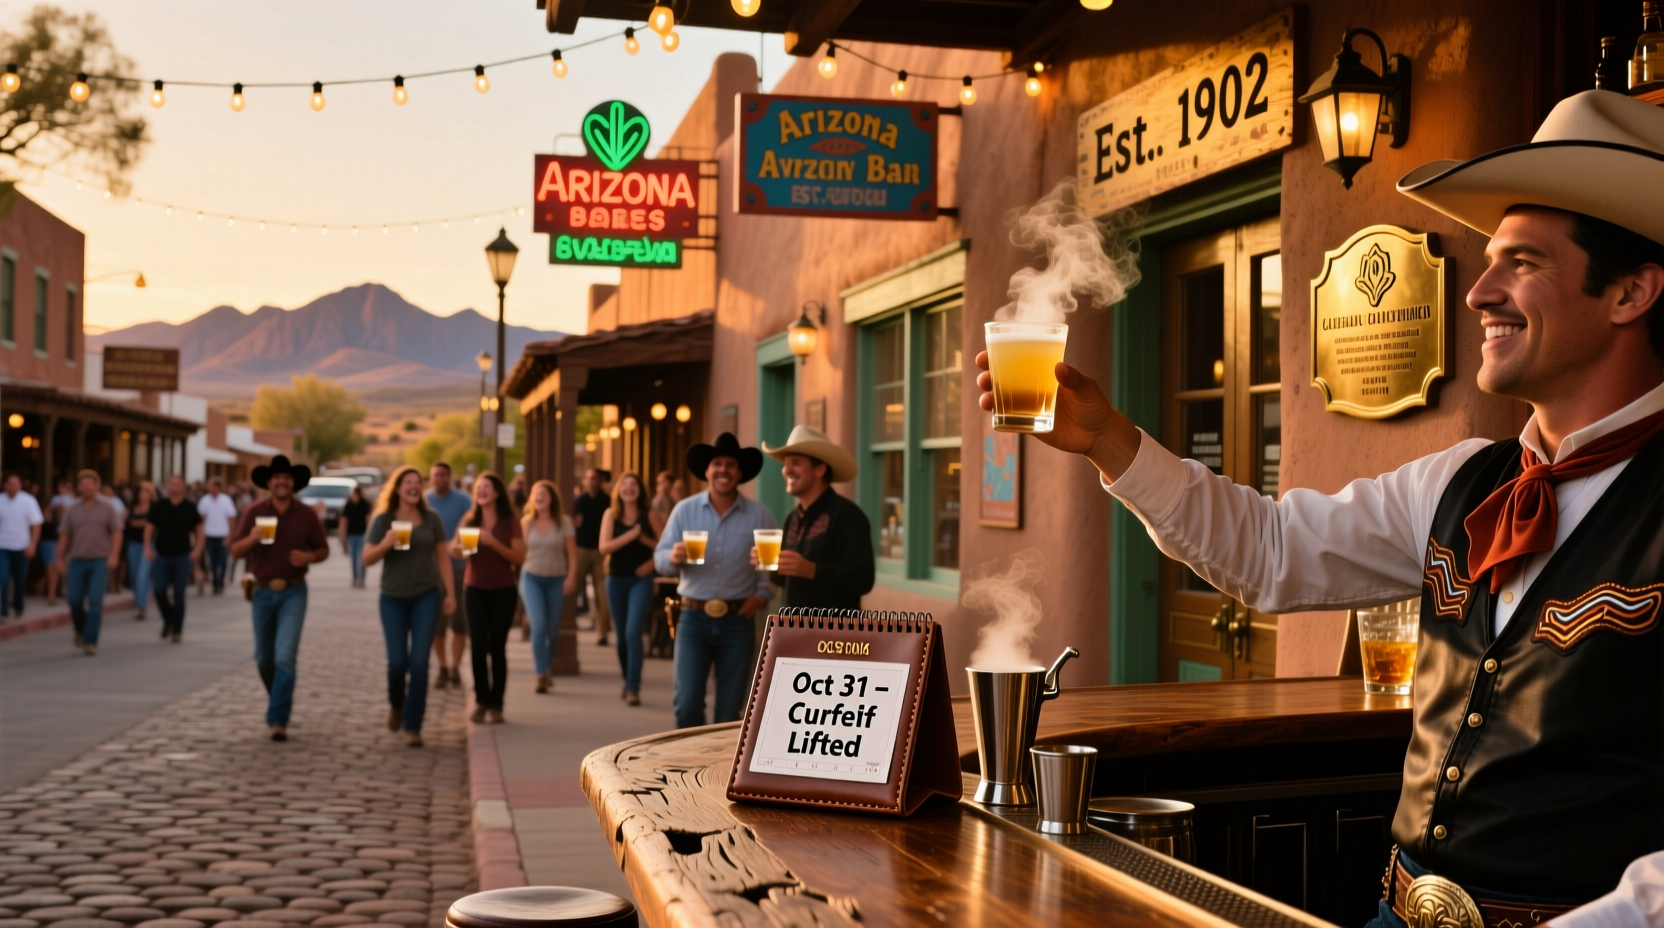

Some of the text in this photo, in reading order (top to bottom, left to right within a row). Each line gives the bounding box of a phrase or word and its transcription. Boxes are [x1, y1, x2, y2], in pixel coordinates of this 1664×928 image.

[778, 108, 898, 150] Arizona
[1094, 52, 1269, 185] Est.. 1902
[537, 161, 696, 209] ARIZONA
[792, 672, 835, 696] Oct
[839, 674, 868, 697] 31
[787, 731, 862, 758] Lifted
